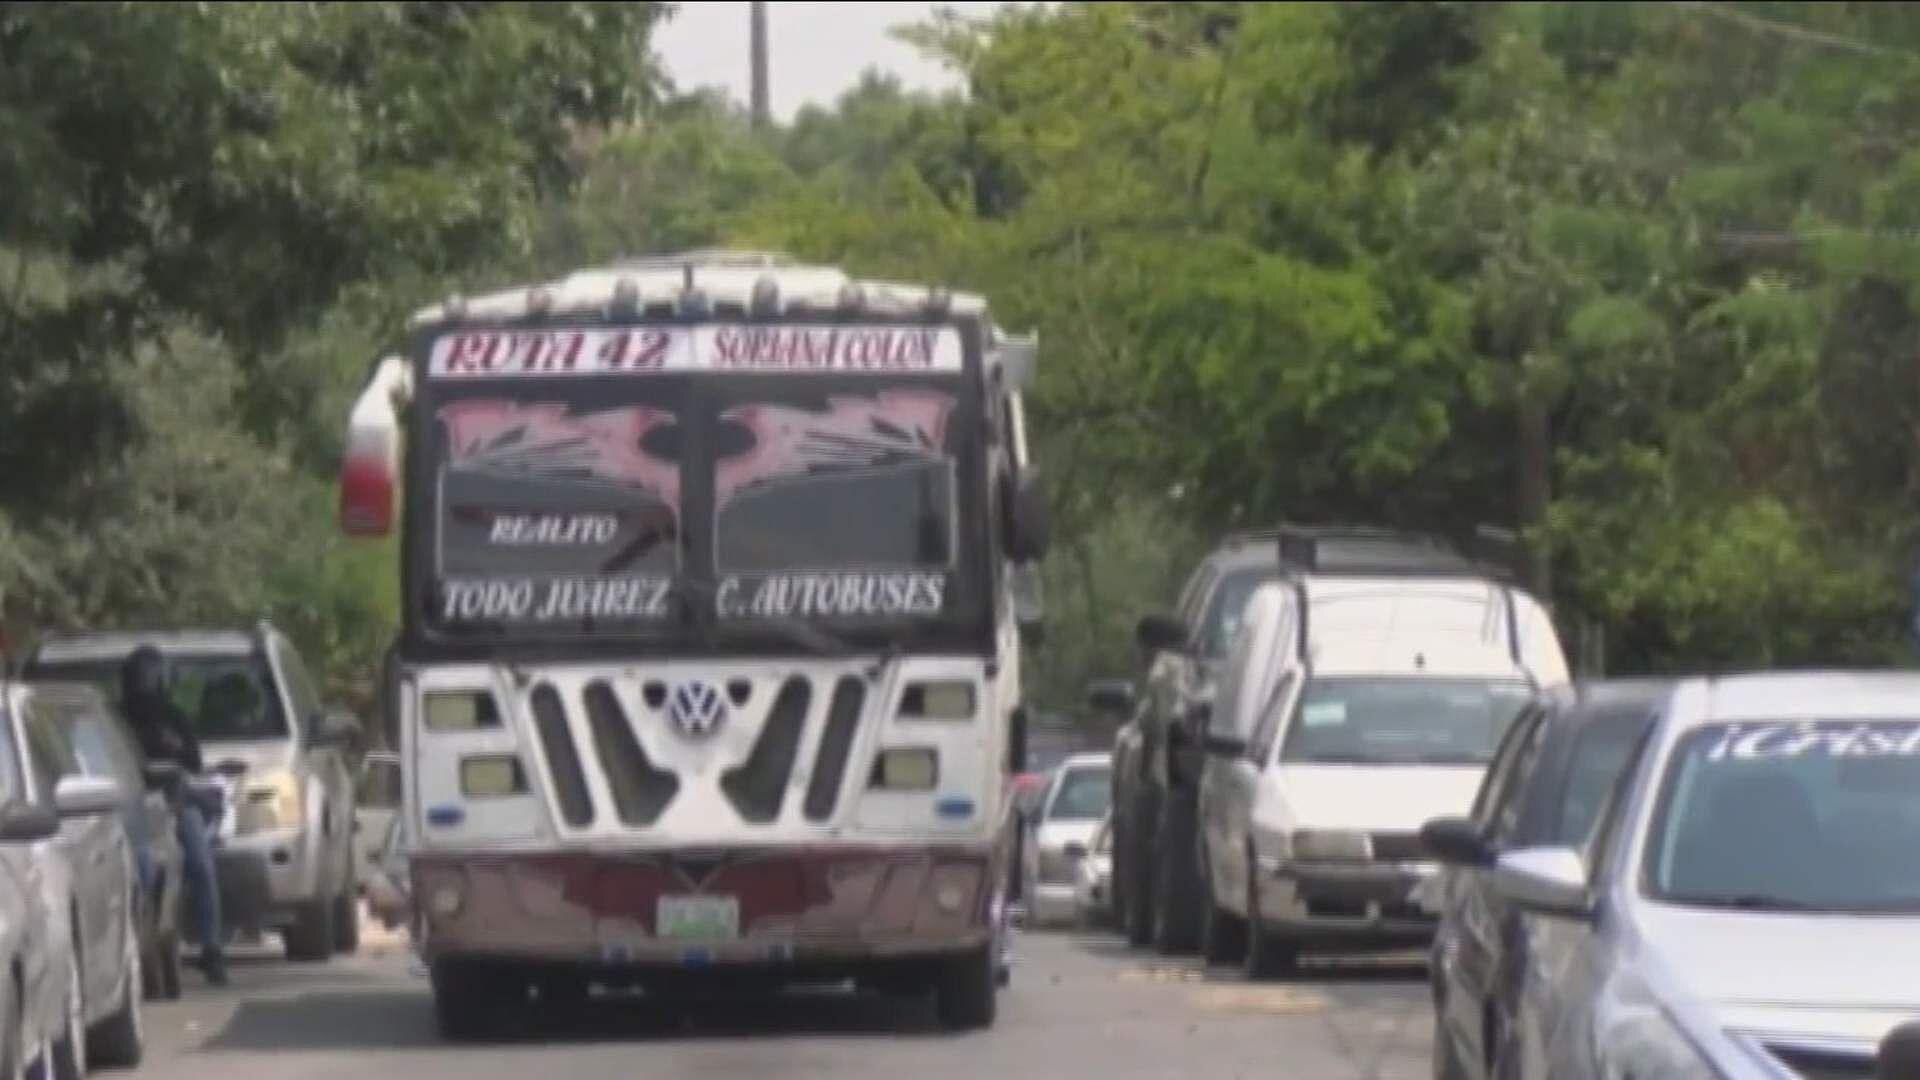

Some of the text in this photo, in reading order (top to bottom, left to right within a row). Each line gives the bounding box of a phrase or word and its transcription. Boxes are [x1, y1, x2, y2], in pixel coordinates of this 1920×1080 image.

[446, 331, 670, 372] RUTA 42
[713, 328, 937, 370] SORIANA COLON
[490, 514, 618, 544] REALITO
[443, 577, 671, 618] TODO JUAREZ
[752, 575, 945, 615] AUTOBUSES
